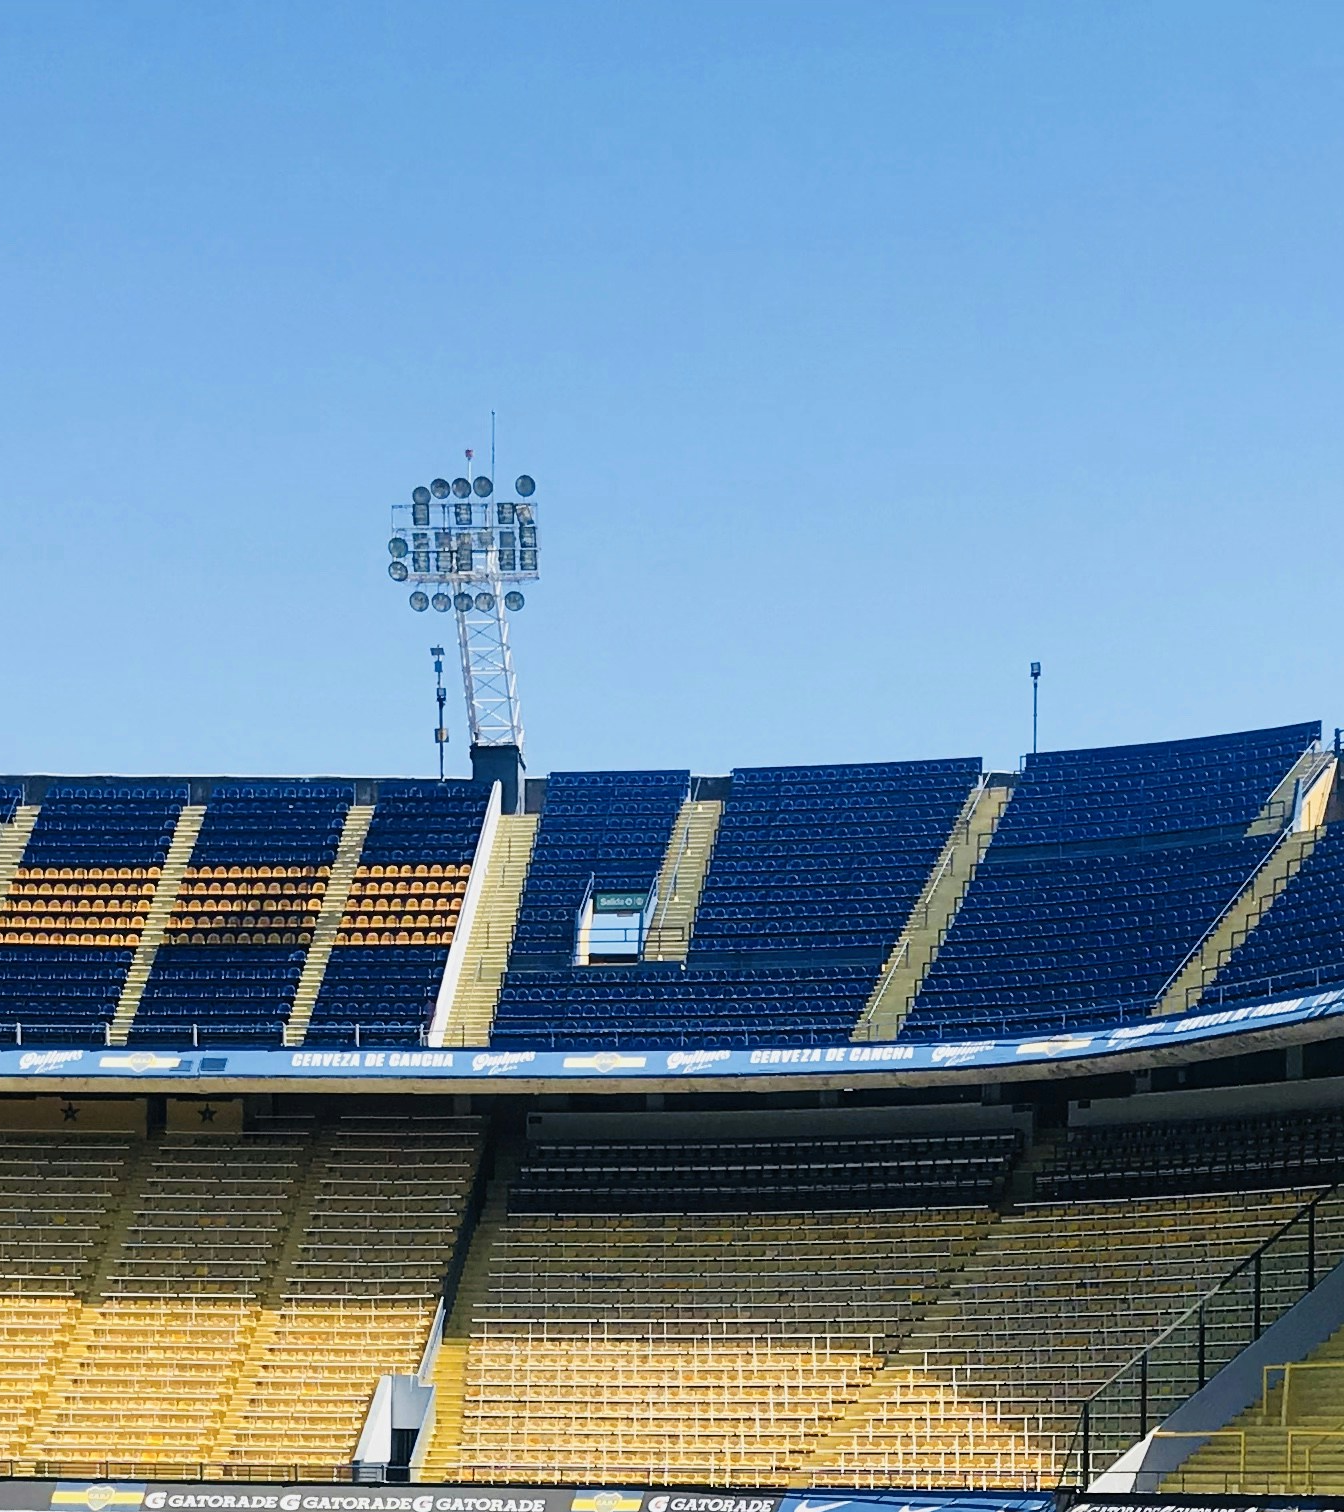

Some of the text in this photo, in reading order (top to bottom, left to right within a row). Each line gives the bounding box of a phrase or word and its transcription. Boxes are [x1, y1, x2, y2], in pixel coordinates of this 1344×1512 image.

[291, 1052, 454, 1068] CERVEZA DE CANCHA
[750, 1046, 914, 1065] CERVEZA DE CANCHA
[168, 1494, 280, 1509] GATORADE
[302, 1496, 413, 1510] GATORADE
[436, 1498, 546, 1512] GATORADE
[671, 1498, 775, 1512] GATORADE
